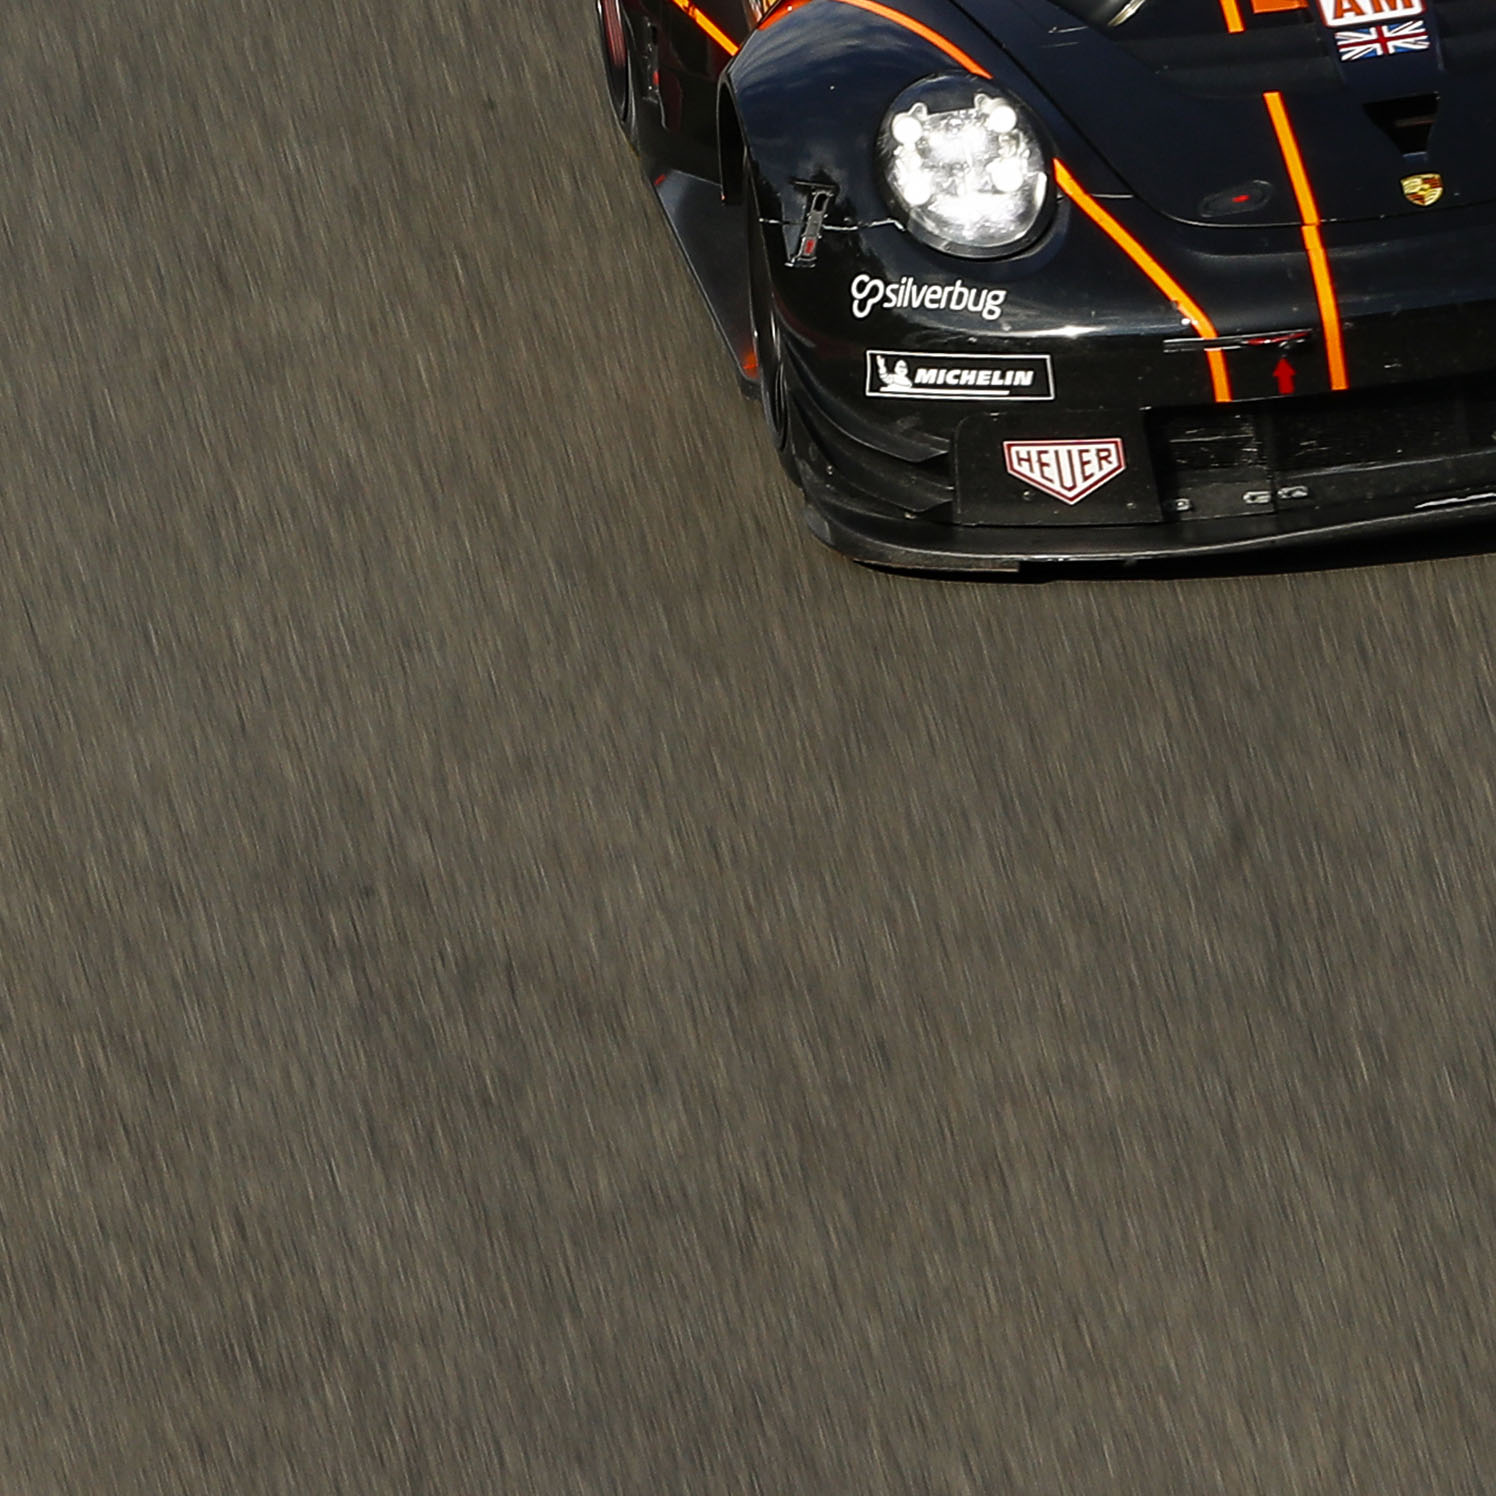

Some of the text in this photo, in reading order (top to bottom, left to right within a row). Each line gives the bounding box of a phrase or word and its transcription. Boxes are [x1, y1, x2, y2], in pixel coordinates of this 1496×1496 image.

[883, 277, 1006, 320] silverbug
[914, 368, 1034, 386] MICHELIN
[1015, 448, 1113, 492] HEUER
